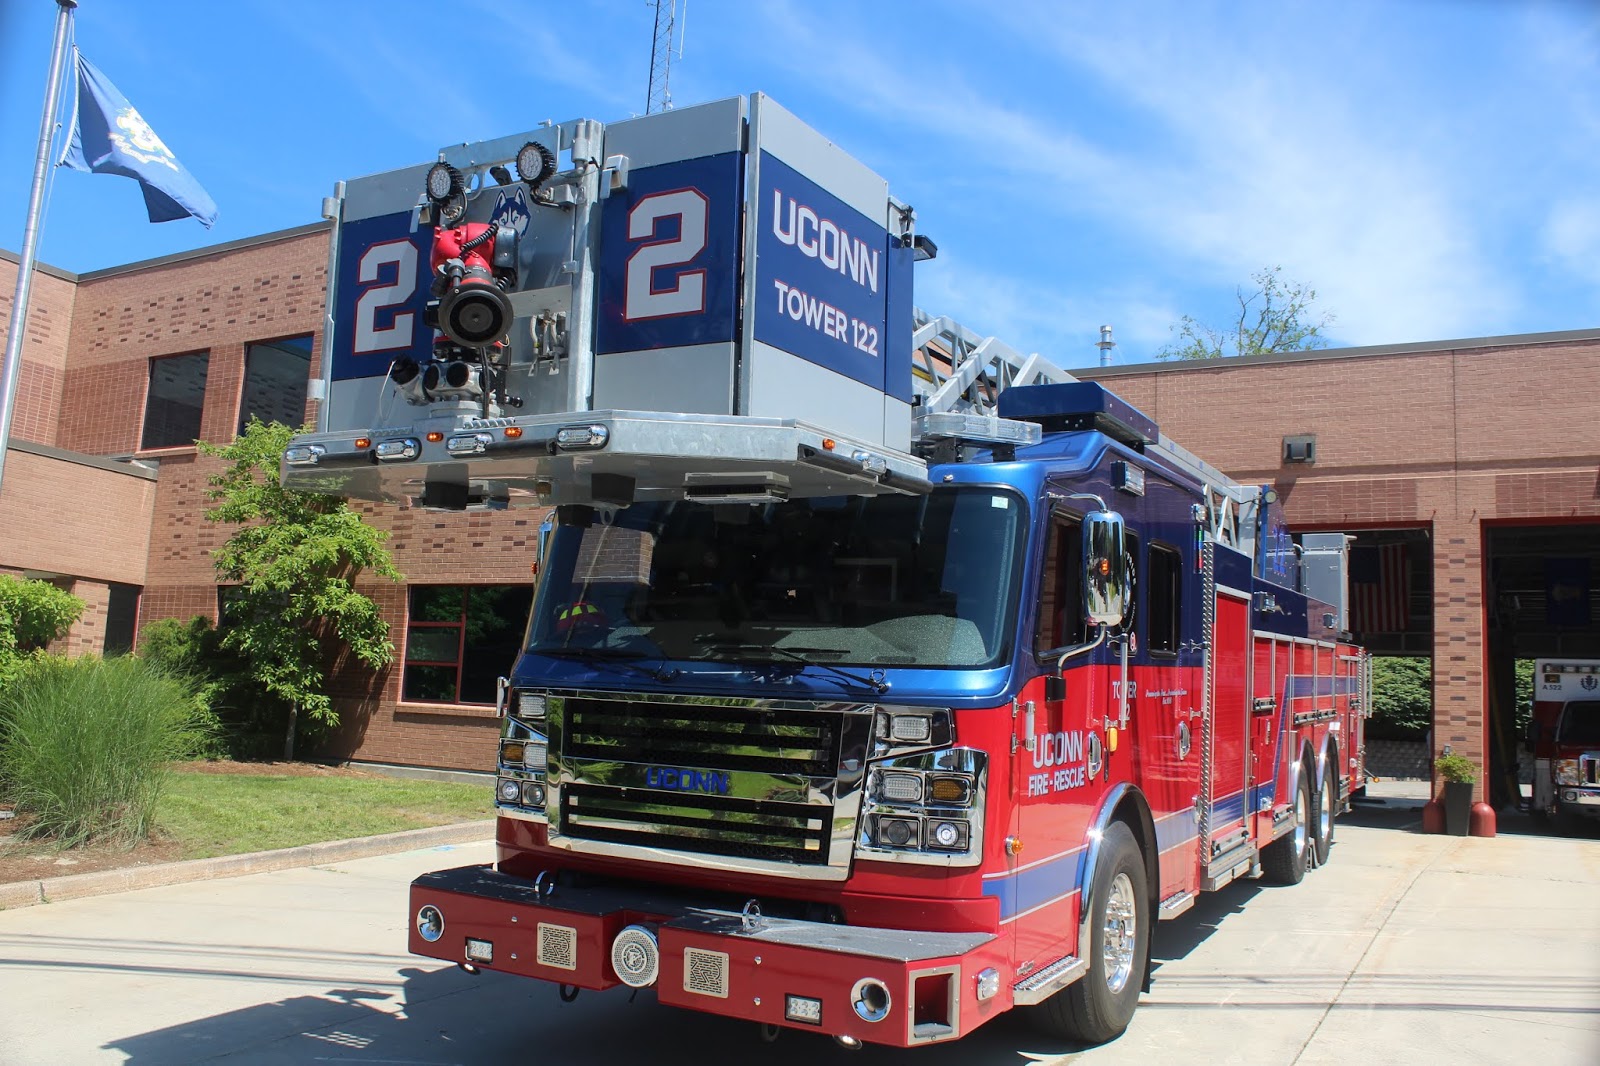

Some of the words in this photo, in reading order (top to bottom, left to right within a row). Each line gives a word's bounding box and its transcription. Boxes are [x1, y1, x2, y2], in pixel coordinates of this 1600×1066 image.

[625, 186, 709, 322] 2
[773, 189, 878, 293] UCONN
[353, 237, 418, 355] 2
[774, 279, 847, 343] TOWER
[851, 318, 878, 358] 122
[1112, 681, 1137, 699] TOER
[646, 767, 728, 793] UCONN
[1033, 730, 1083, 769] UCONN
